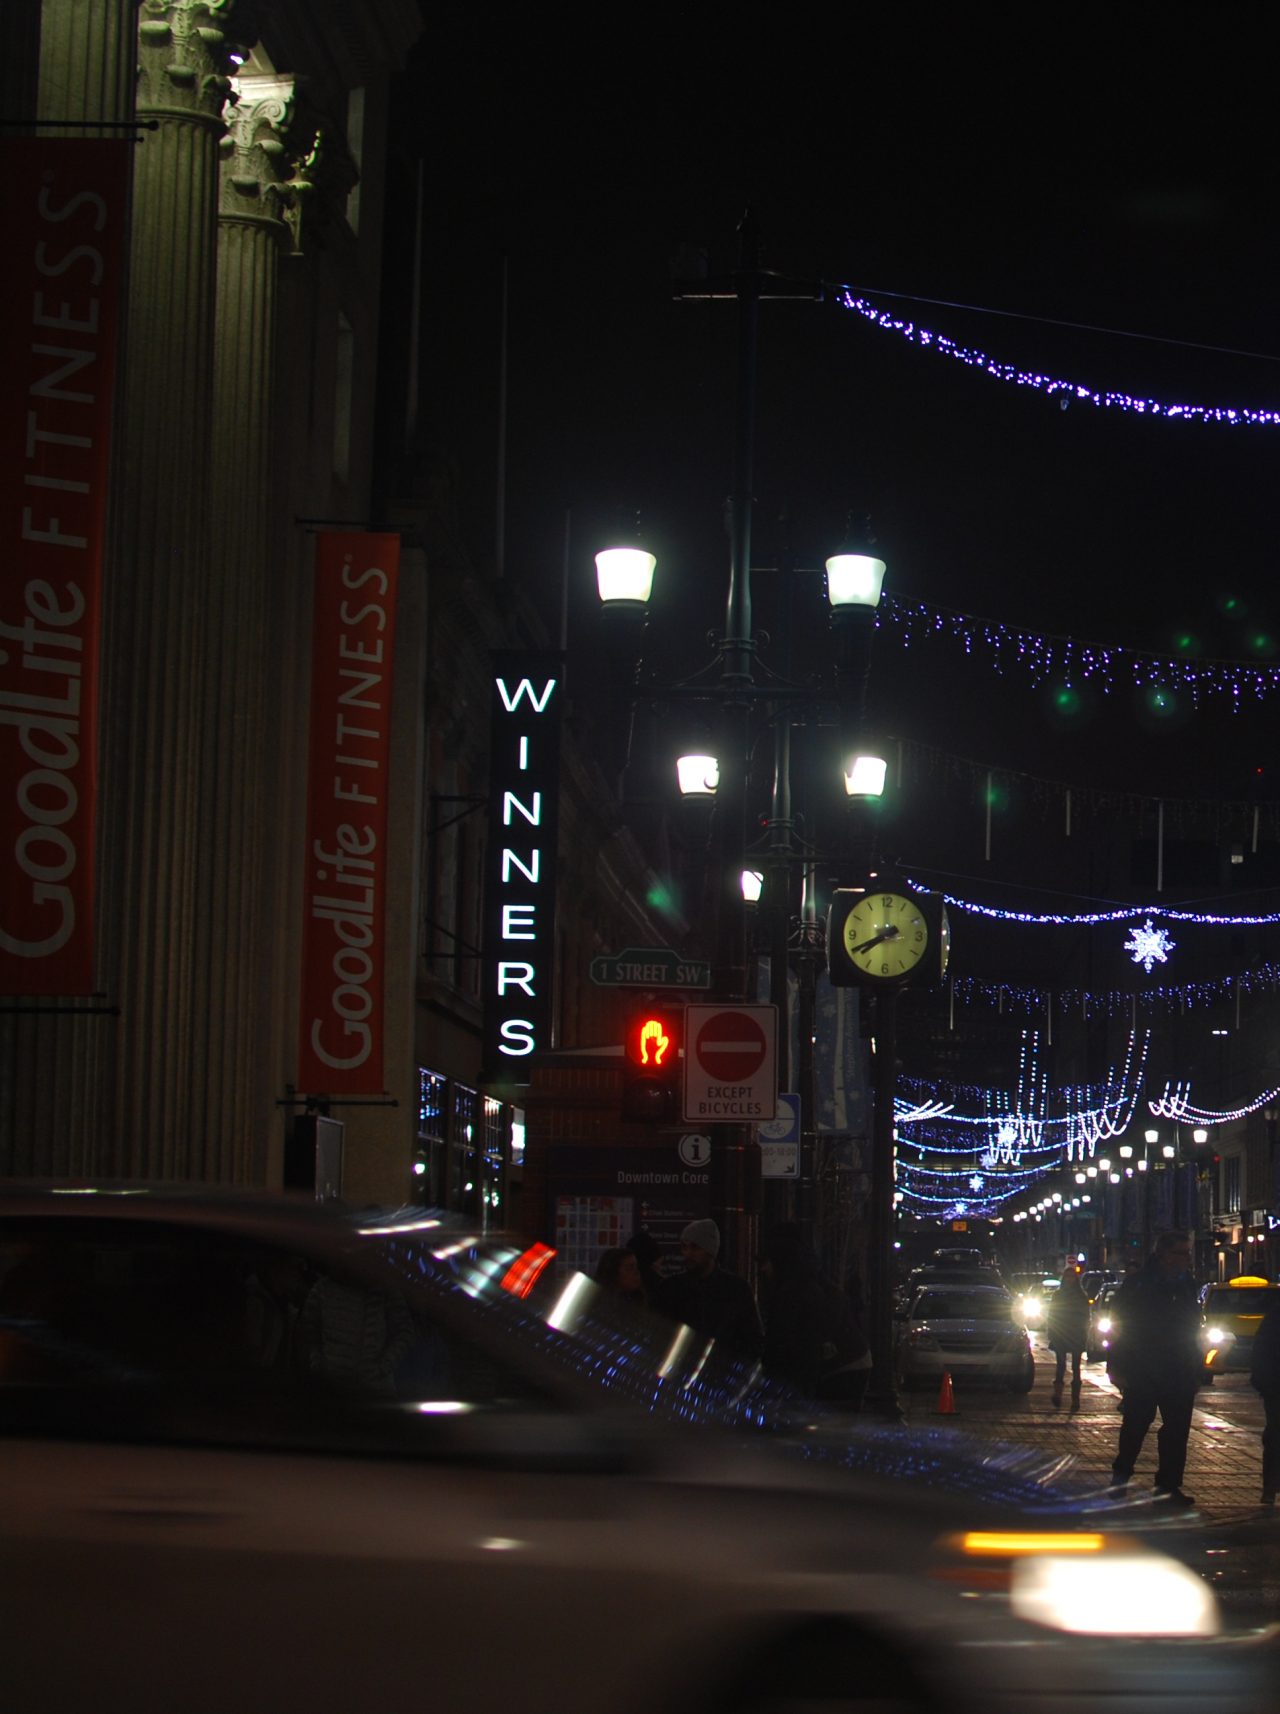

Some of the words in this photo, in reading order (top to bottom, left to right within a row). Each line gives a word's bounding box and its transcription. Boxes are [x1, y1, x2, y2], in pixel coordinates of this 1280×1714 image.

[22, 188, 109, 550] FITNESS
[334, 567, 389, 805] FITNESS
[0, 577, 87, 960] GoodLife
[495, 677, 557, 1057] WINNERS
[882, 896, 893, 908] 12
[848, 929, 857, 940] 9
[915, 930, 923, 942] 3
[311, 823, 377, 1071] GoodLife
[600, 964, 608, 980] 1
[615, 963, 669, 982] STREET
[676, 965, 701, 984] SW
[881, 963, 889, 974] 6
[707, 1086, 753, 1099] EXCEPT
[698, 1102, 762, 1114] BICYCLES
[617, 1171, 680, 1184] Downtown
[681, 1171, 710, 1184] Core
